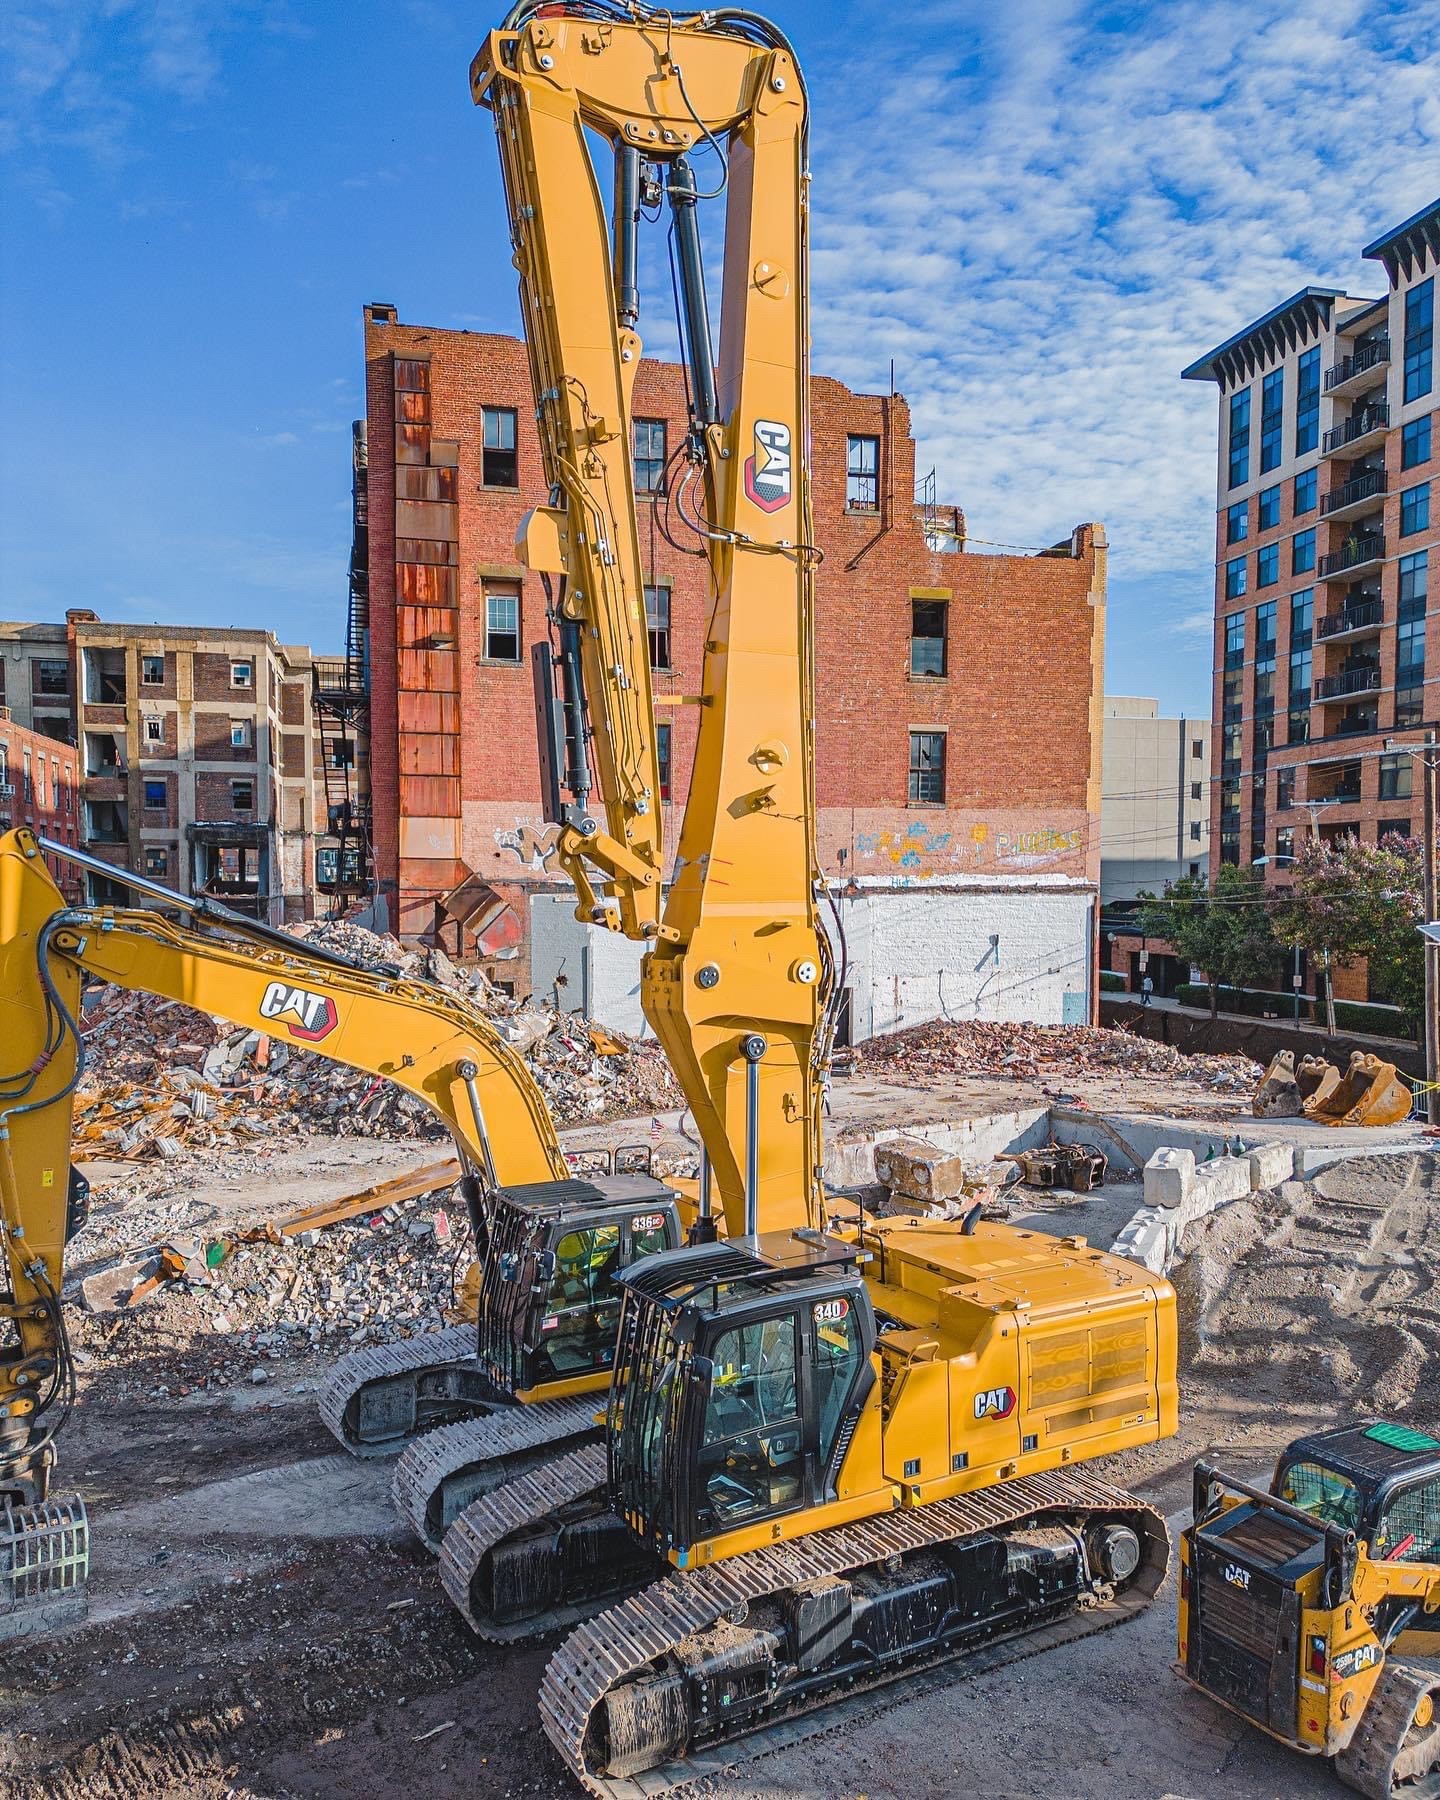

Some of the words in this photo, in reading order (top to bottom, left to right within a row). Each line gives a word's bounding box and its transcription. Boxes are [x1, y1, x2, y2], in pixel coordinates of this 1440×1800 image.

[754, 420, 791, 494] CAT
[260, 982, 327, 1029] CAT
[632, 1215, 653, 1229] 336
[814, 1301, 841, 1321] 340
[974, 1387, 1007, 1418] CAT
[1225, 1563, 1251, 1586] CAT
[1354, 1645, 1379, 1671] CAT
